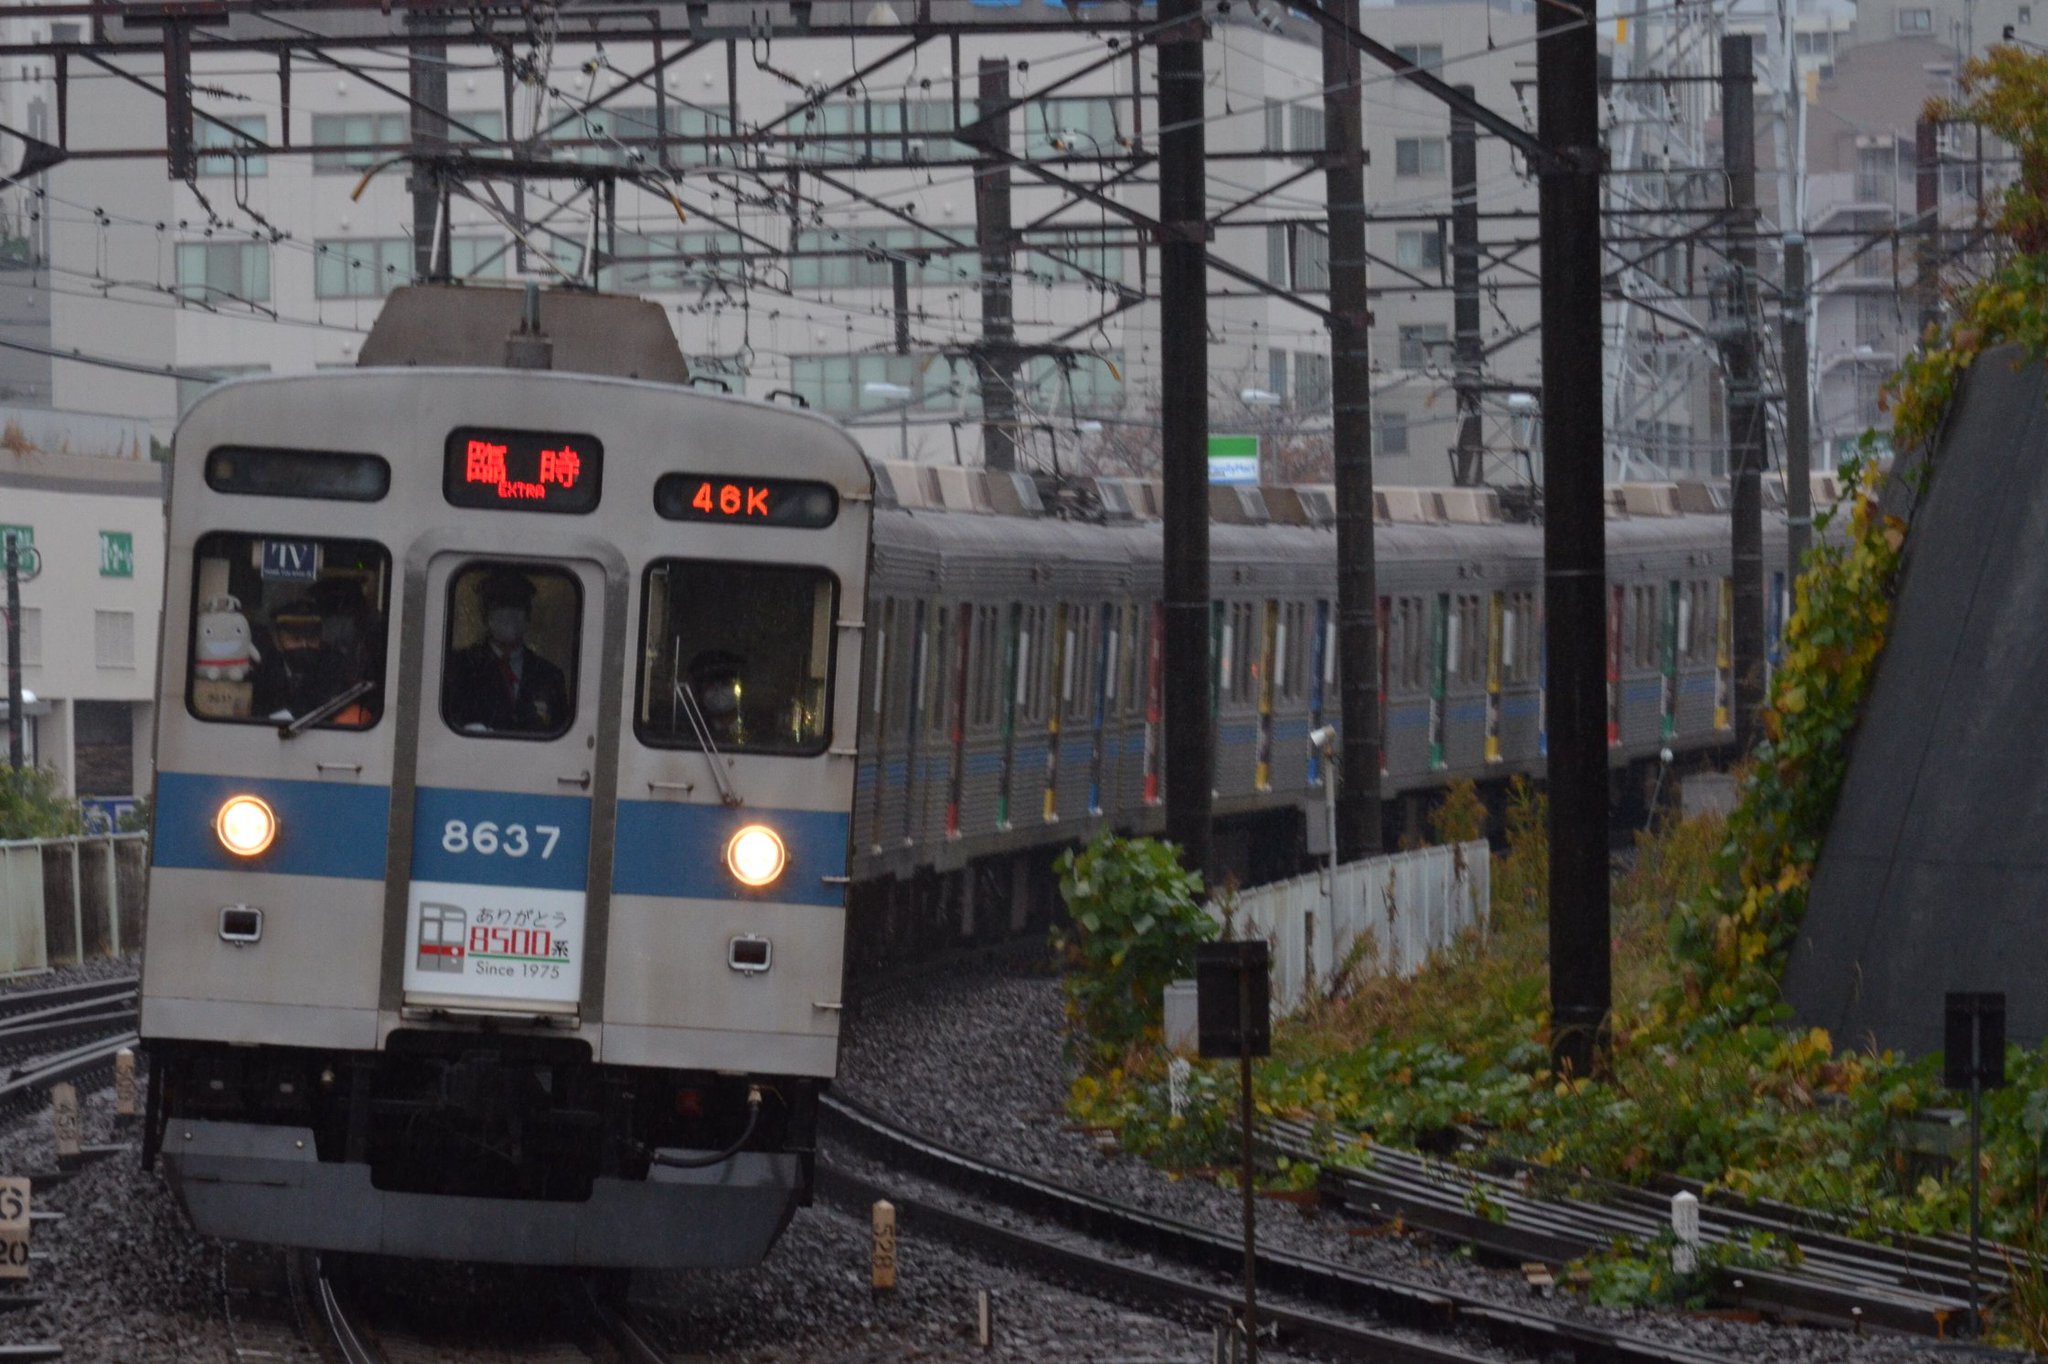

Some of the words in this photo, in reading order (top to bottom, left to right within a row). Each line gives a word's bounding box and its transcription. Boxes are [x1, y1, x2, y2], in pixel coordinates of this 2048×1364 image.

[498, 481, 546, 498] EXTRA
[692, 482, 769, 516] 46K
[442, 819, 561, 860] 8637
[475, 907, 567, 928] ありがとう
[475, 961, 514, 976] Since
[523, 964, 560, 979] 1975
